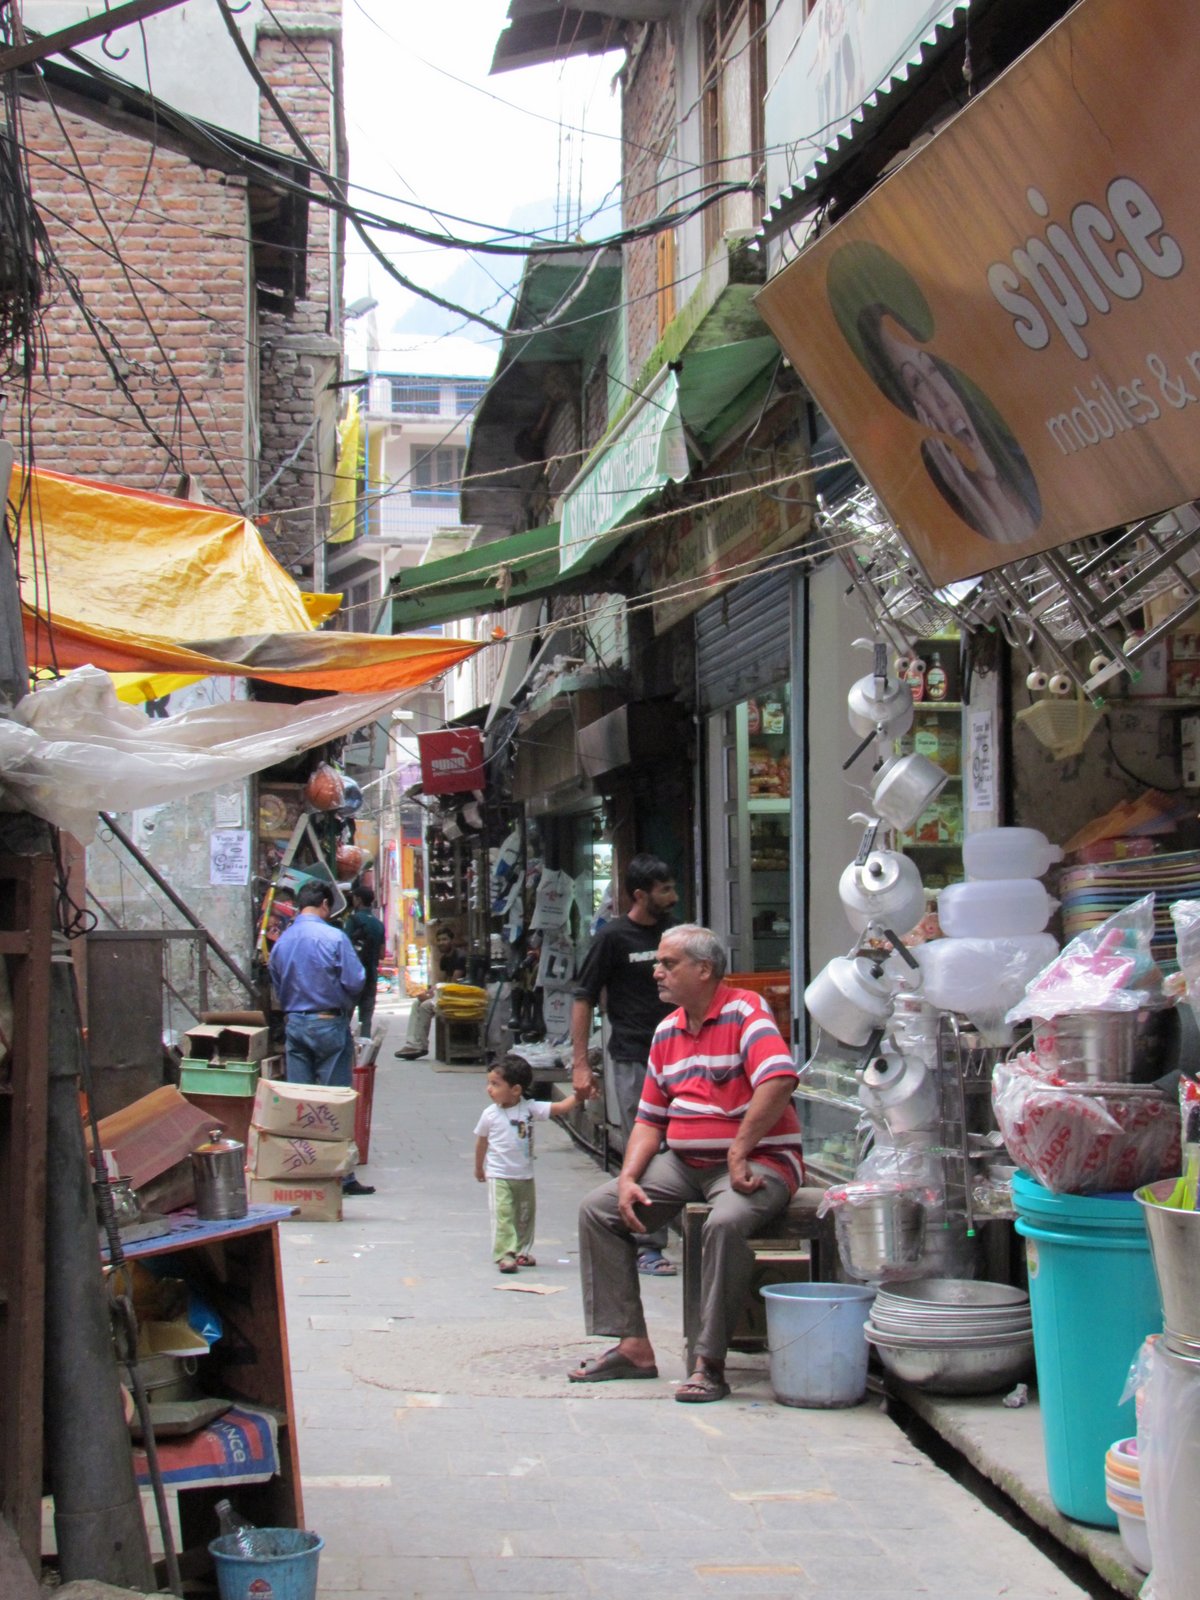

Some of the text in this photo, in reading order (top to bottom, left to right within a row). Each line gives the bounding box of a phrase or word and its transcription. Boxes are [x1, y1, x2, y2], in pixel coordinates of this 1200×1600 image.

[986, 176, 1184, 361] spice
[1045, 374, 1160, 455] mobiles
[1145, 352, 1198, 409] &
